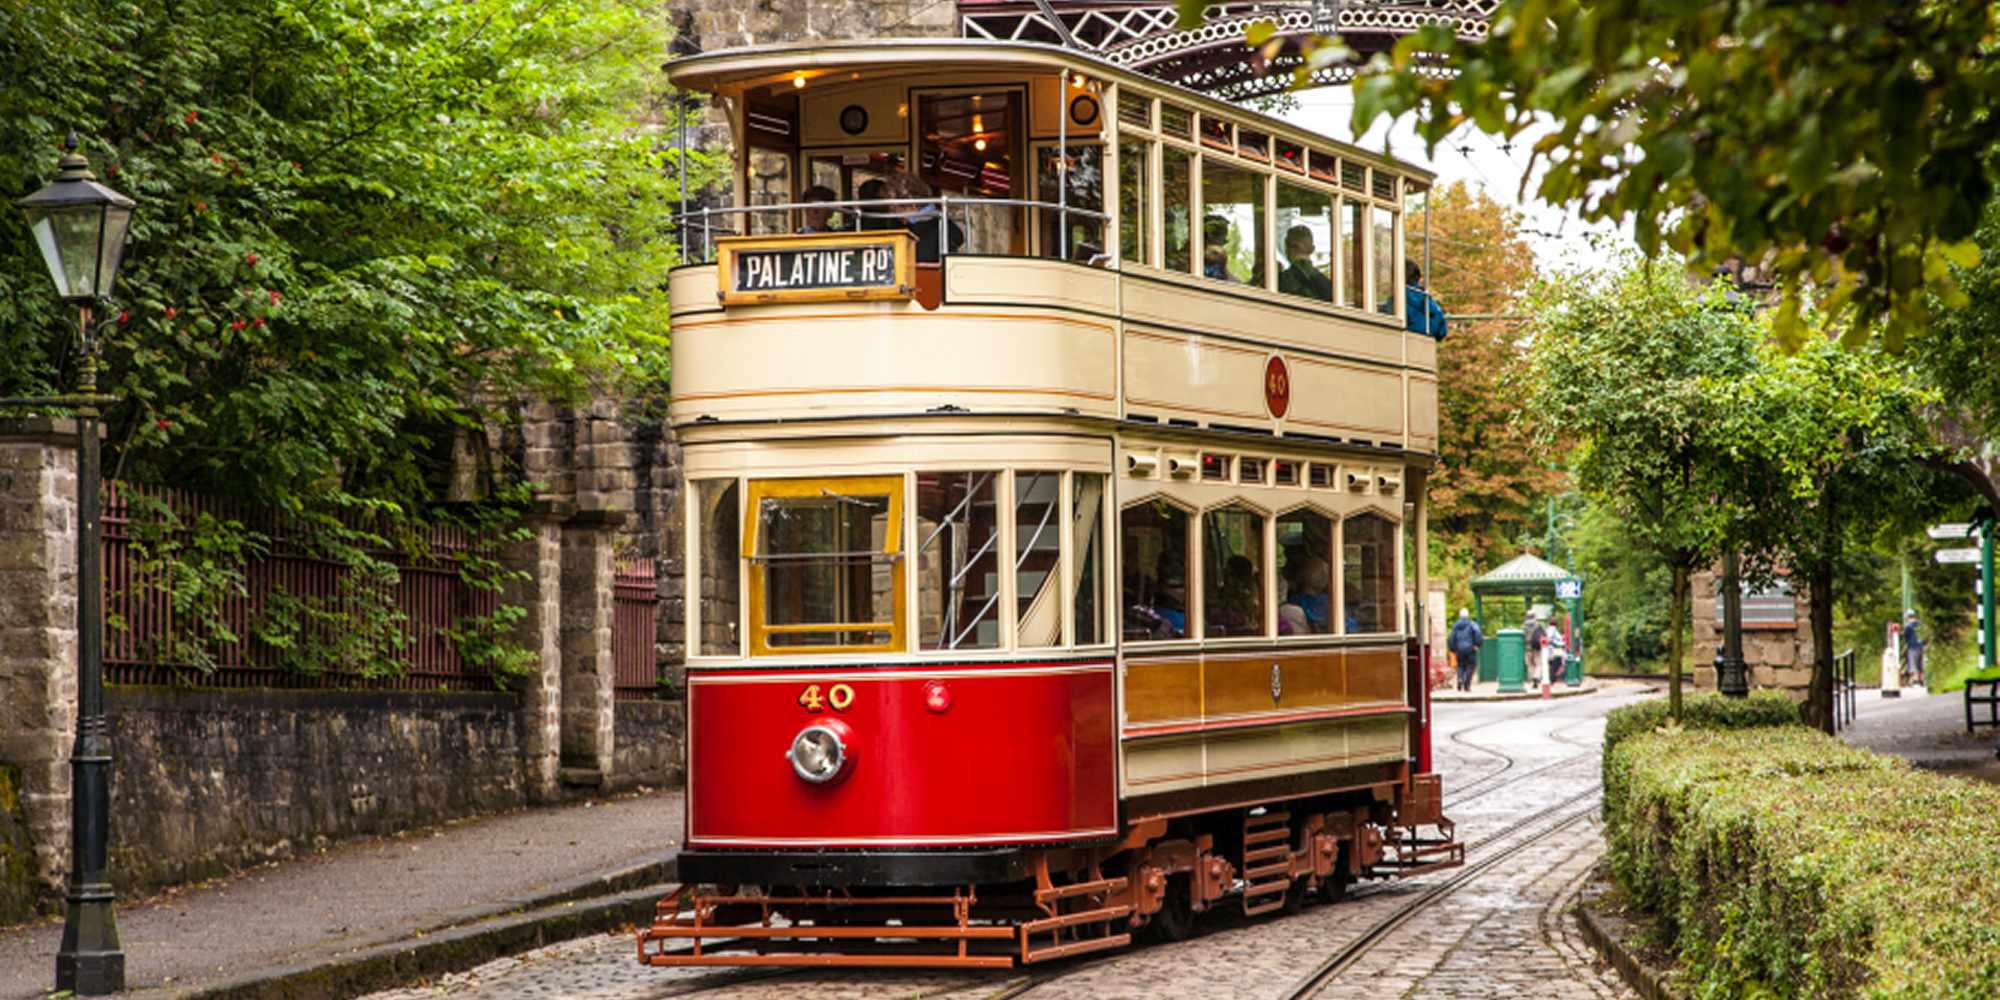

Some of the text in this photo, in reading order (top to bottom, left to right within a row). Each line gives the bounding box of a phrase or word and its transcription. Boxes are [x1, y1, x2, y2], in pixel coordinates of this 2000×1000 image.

[746, 251, 854, 288] PALATINE
[1269, 373, 1286, 396] 40
[799, 684, 855, 712] 40
